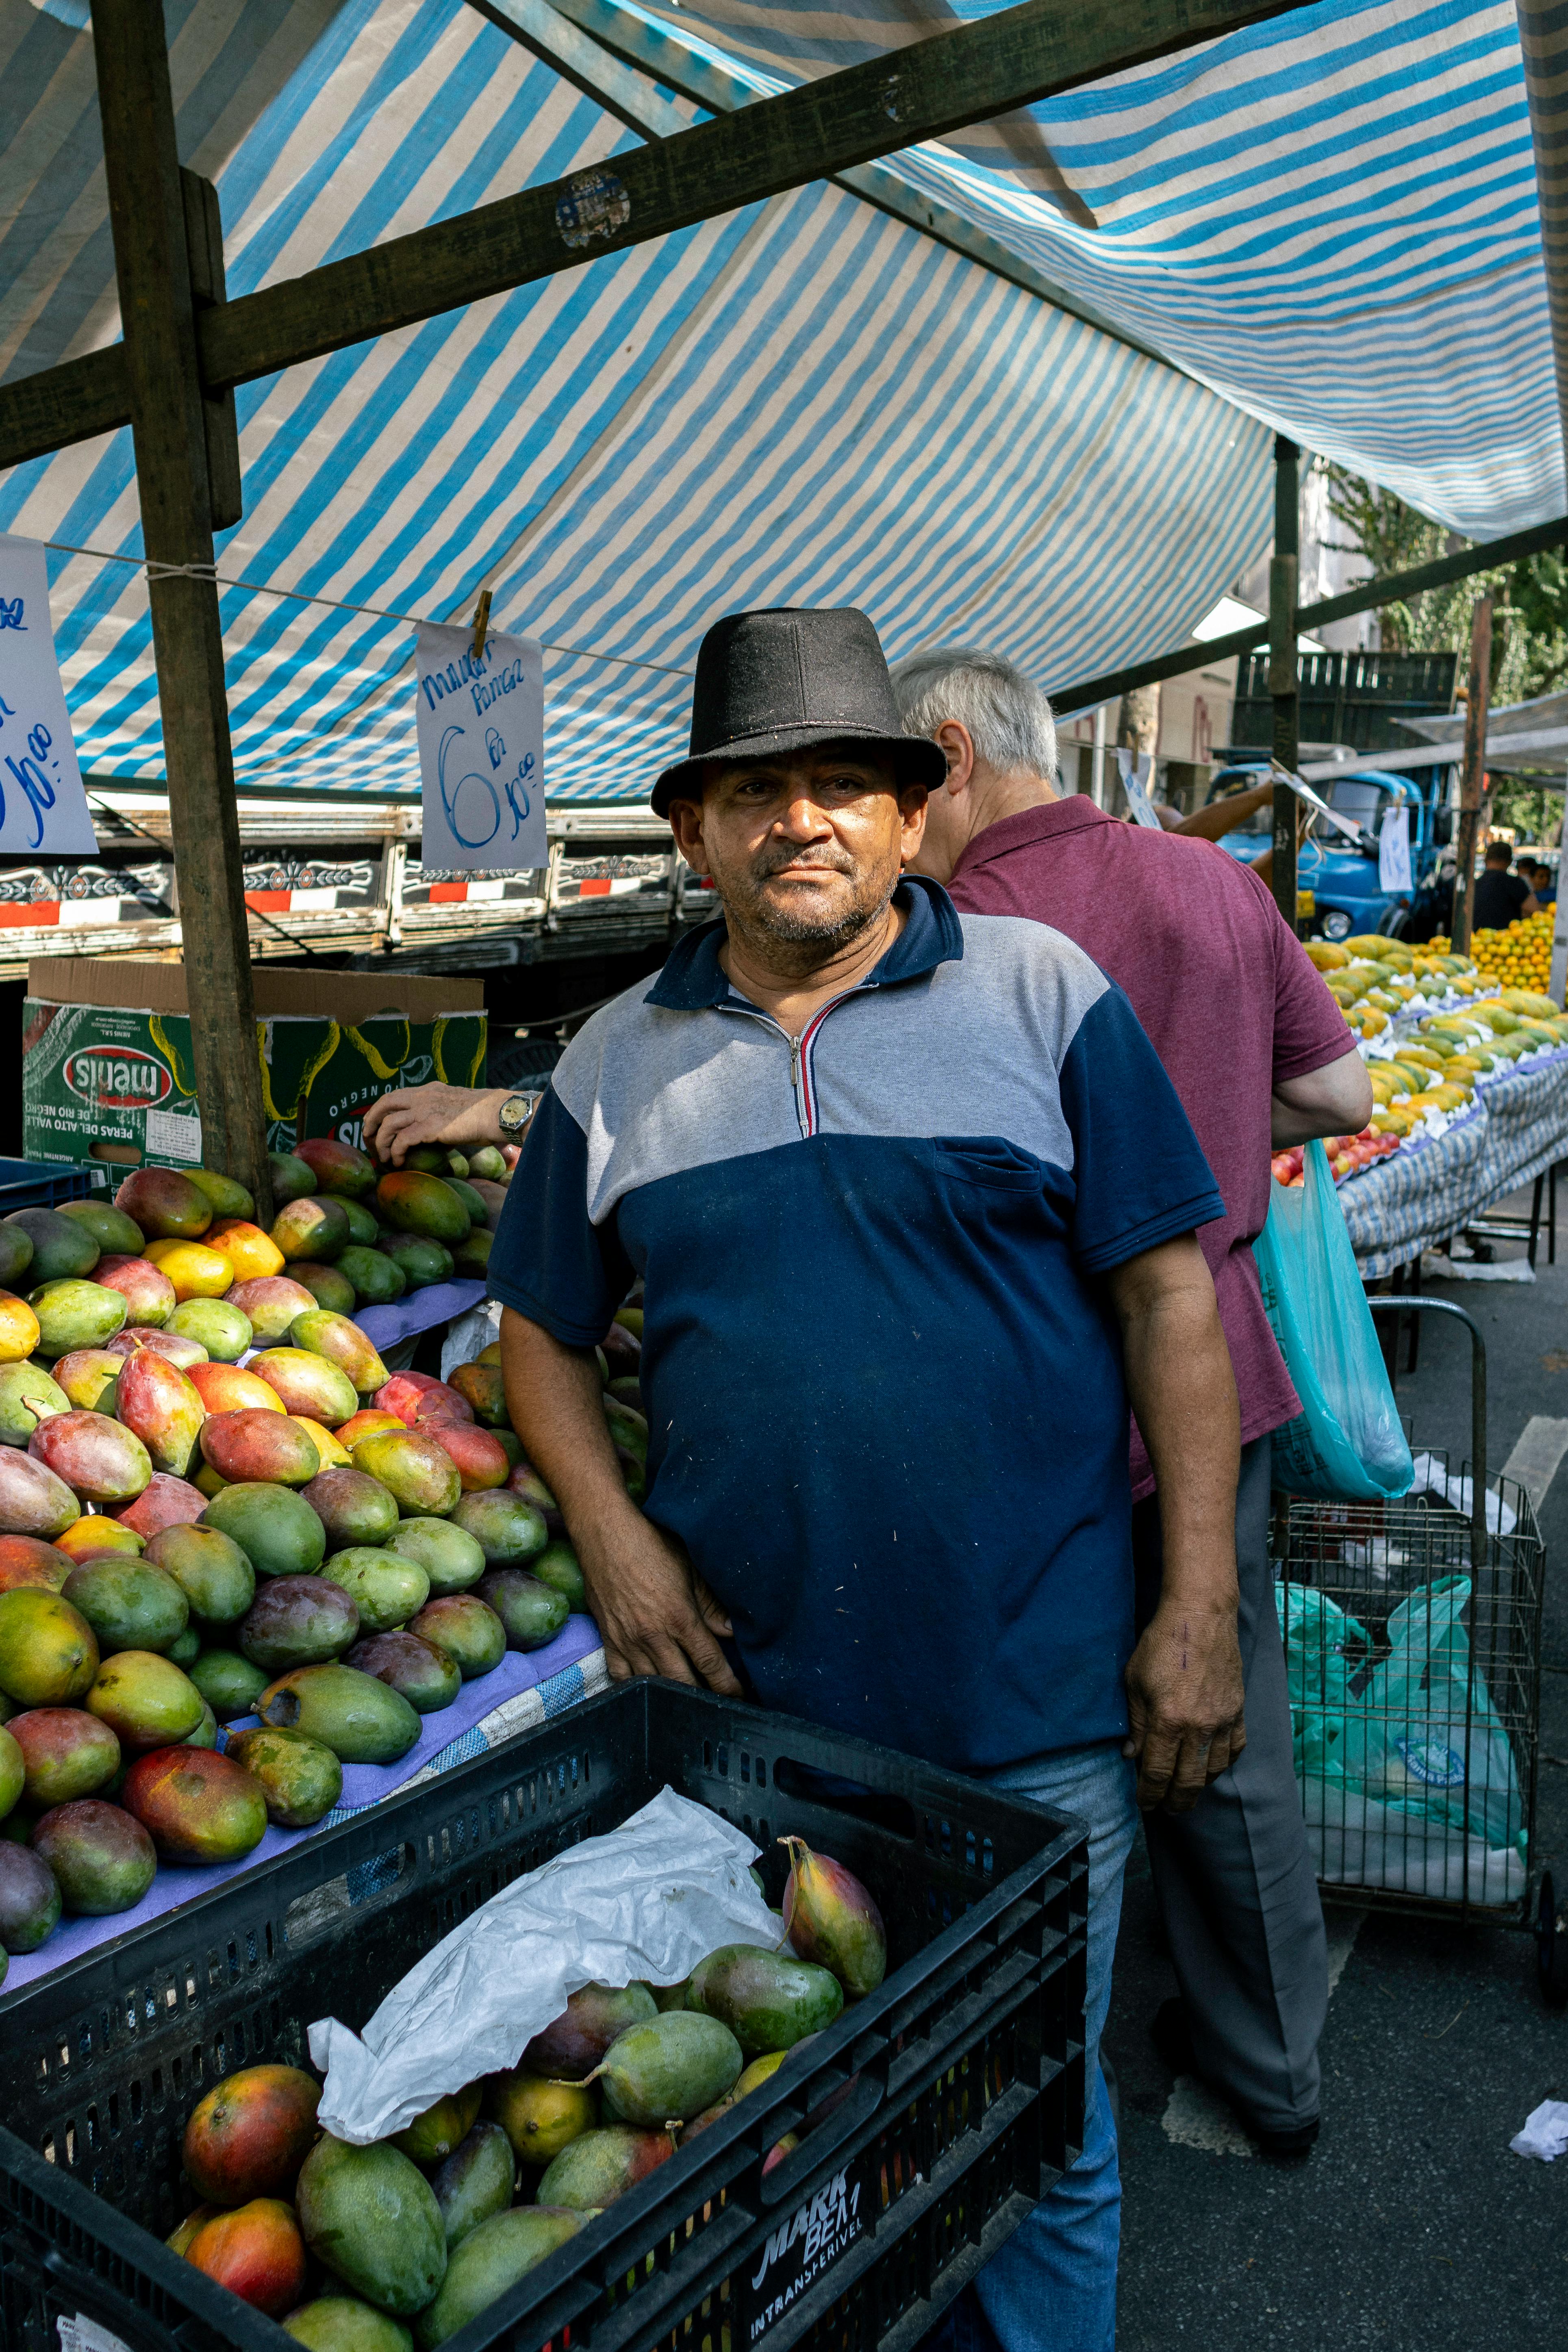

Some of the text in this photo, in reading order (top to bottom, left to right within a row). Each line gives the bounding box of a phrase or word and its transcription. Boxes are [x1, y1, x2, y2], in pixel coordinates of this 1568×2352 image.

[438, 725, 500, 849] 6
[75, 1058, 157, 1096] menis
[329, 1085, 378, 1118] NEGRO
[59, 1106, 75, 1118] RIO
[78, 1109, 90, 1121] DE
[54, 1118, 77, 1132] ALTO
[80, 1123, 98, 1135] DEL
[100, 1125, 133, 1139] PERAS
[43, 1151, 74, 1162] ARGENTINE
